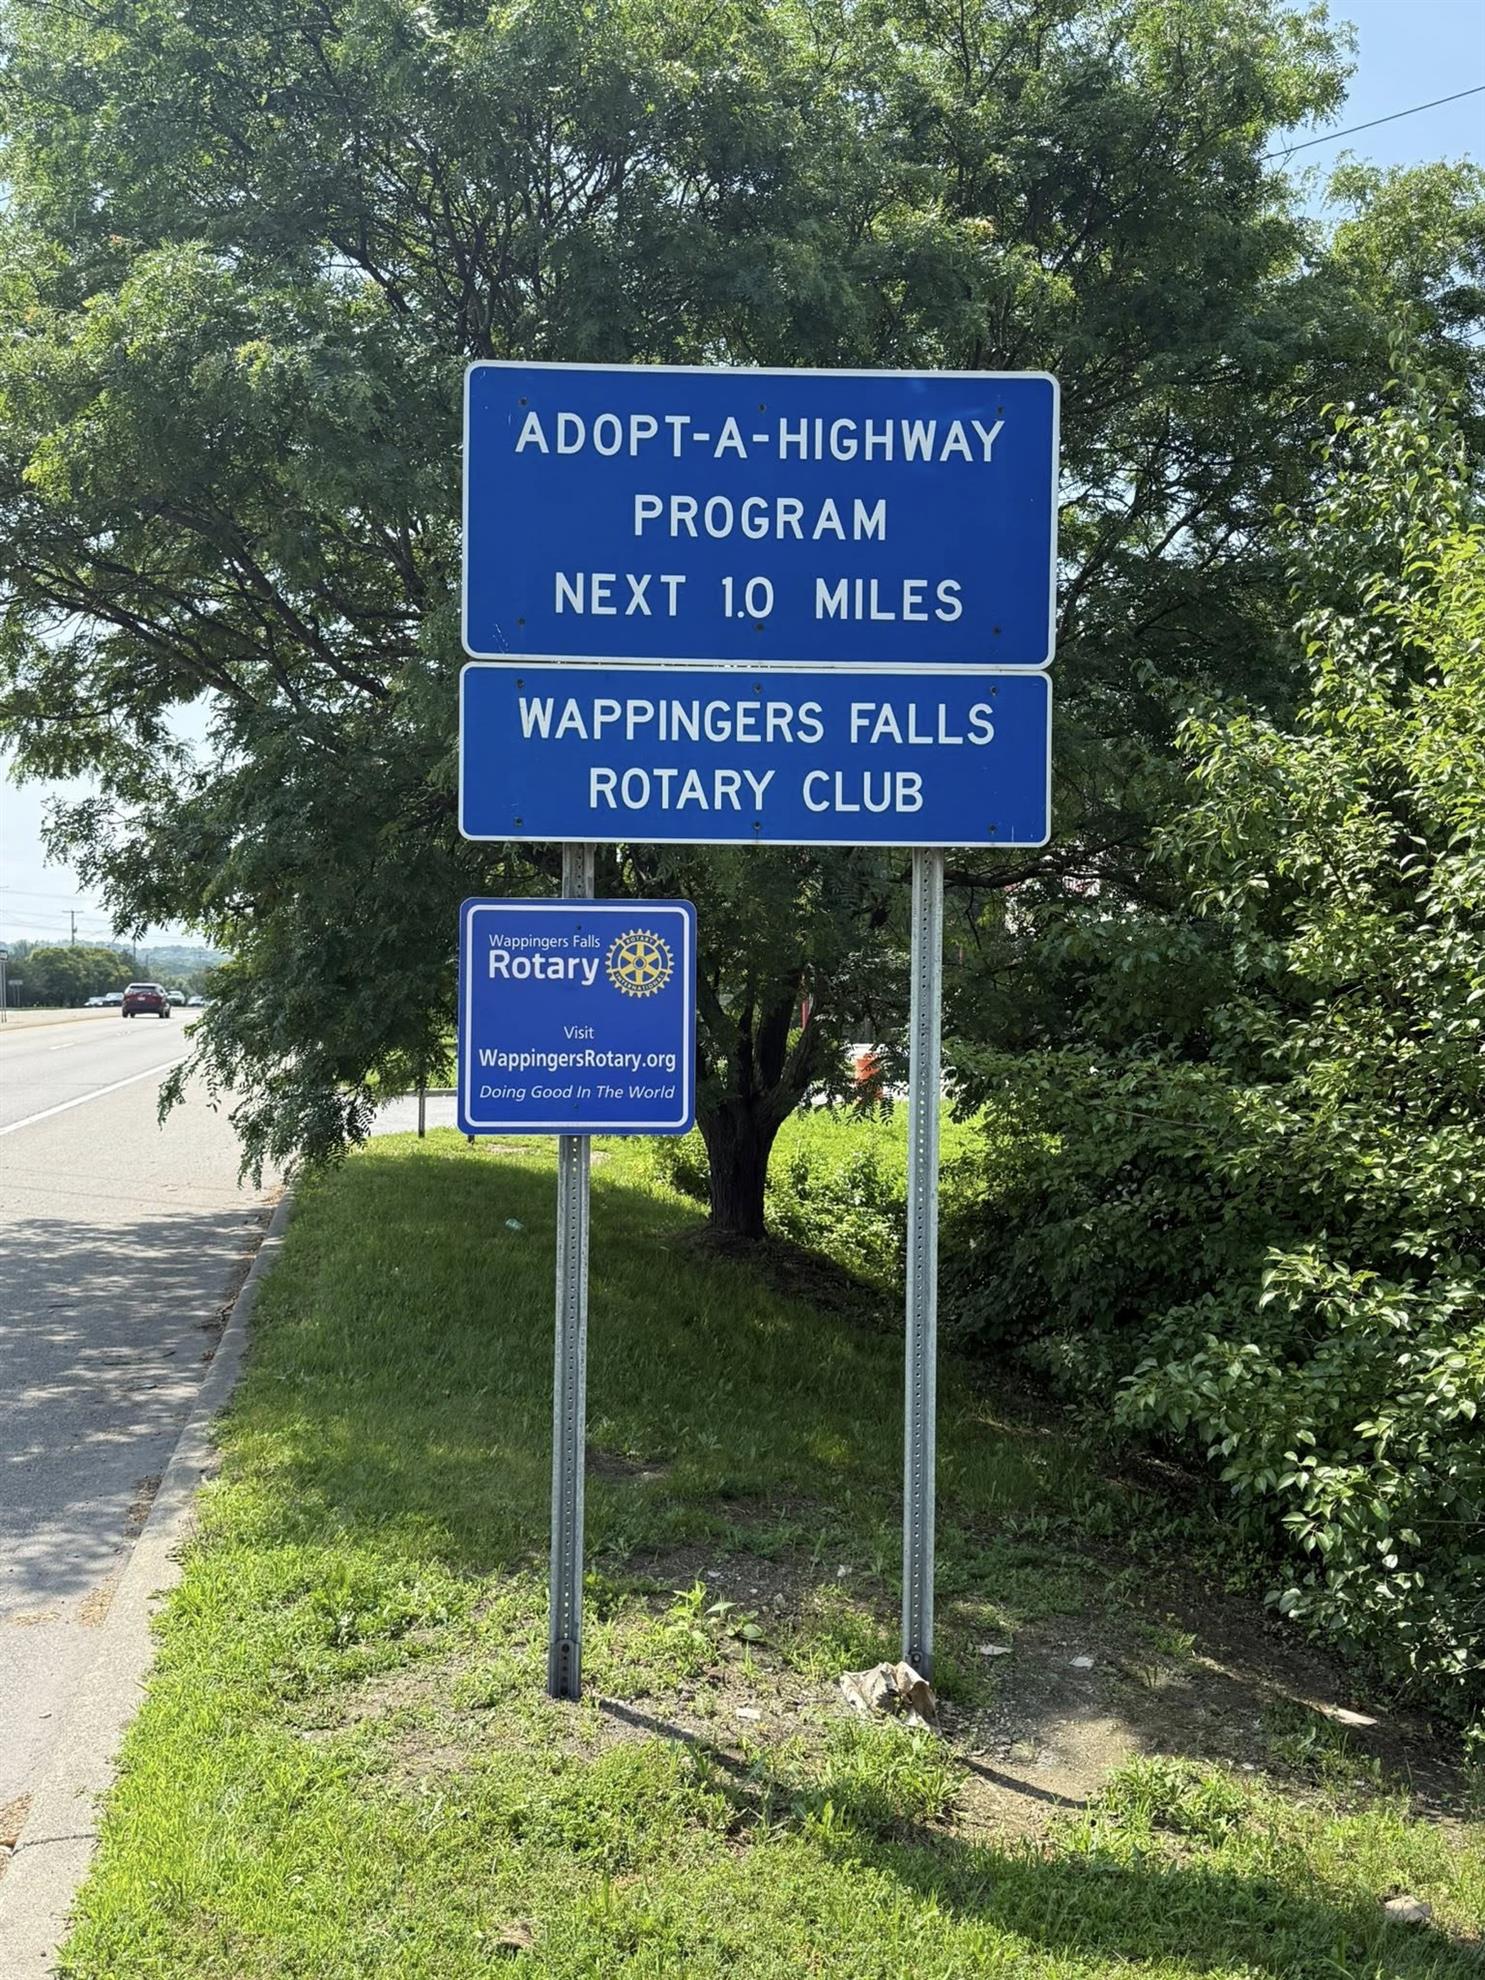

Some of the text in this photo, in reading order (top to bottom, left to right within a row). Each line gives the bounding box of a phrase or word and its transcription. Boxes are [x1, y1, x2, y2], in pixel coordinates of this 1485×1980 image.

[516, 412, 1004, 461] ADOPT-A-HIGHWAY
[635, 495, 885, 540] PROGRAM
[556, 572, 962, 621] NEXT 1.0 MILES
[519, 698, 994, 744] WAPPINGERS FALLS
[591, 768, 923, 812] ROTARY CLUB
[488, 934, 601, 950] Wappingers Falls
[489, 949, 600, 985] Rotary
[615, 972, 664, 990] INTERNATIONAL
[563, 1026, 594, 1039] Visit
[478, 1048, 676, 1072] WappingersRotary.org
[479, 1086, 676, 1101] Doing Good In The World
